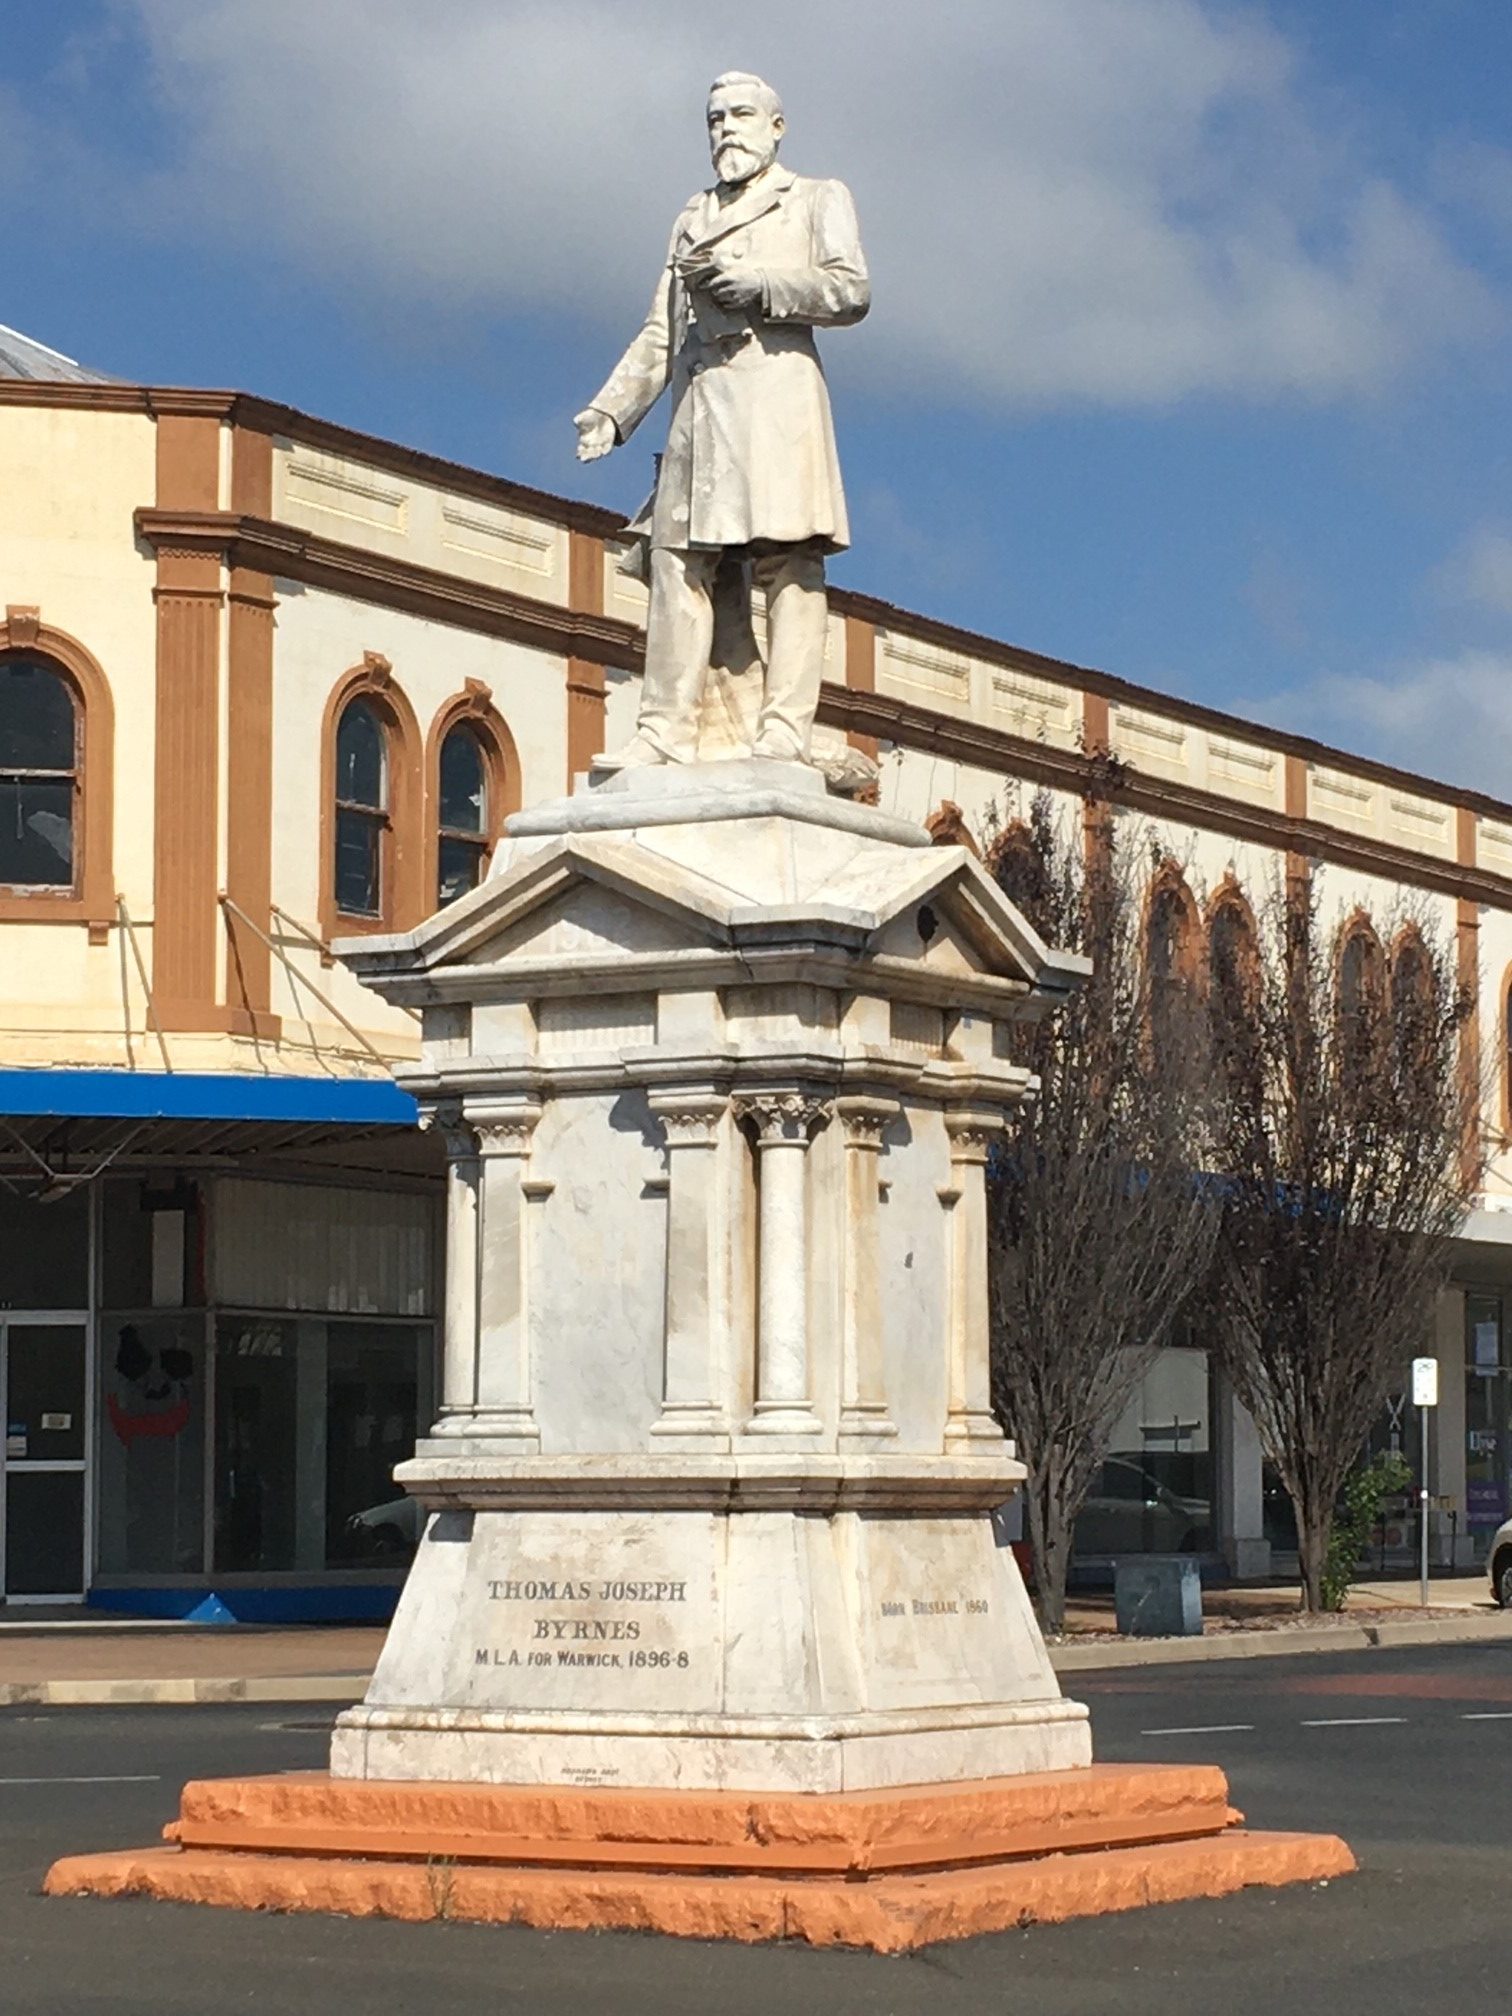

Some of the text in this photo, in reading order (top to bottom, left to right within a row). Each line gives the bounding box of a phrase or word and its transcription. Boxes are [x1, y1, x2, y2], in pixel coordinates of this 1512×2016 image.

[487, 1580, 687, 1601] THOMAS JOSEPH
[533, 1619, 640, 1640] BYRNES
[527, 1651, 552, 1666] FOR
